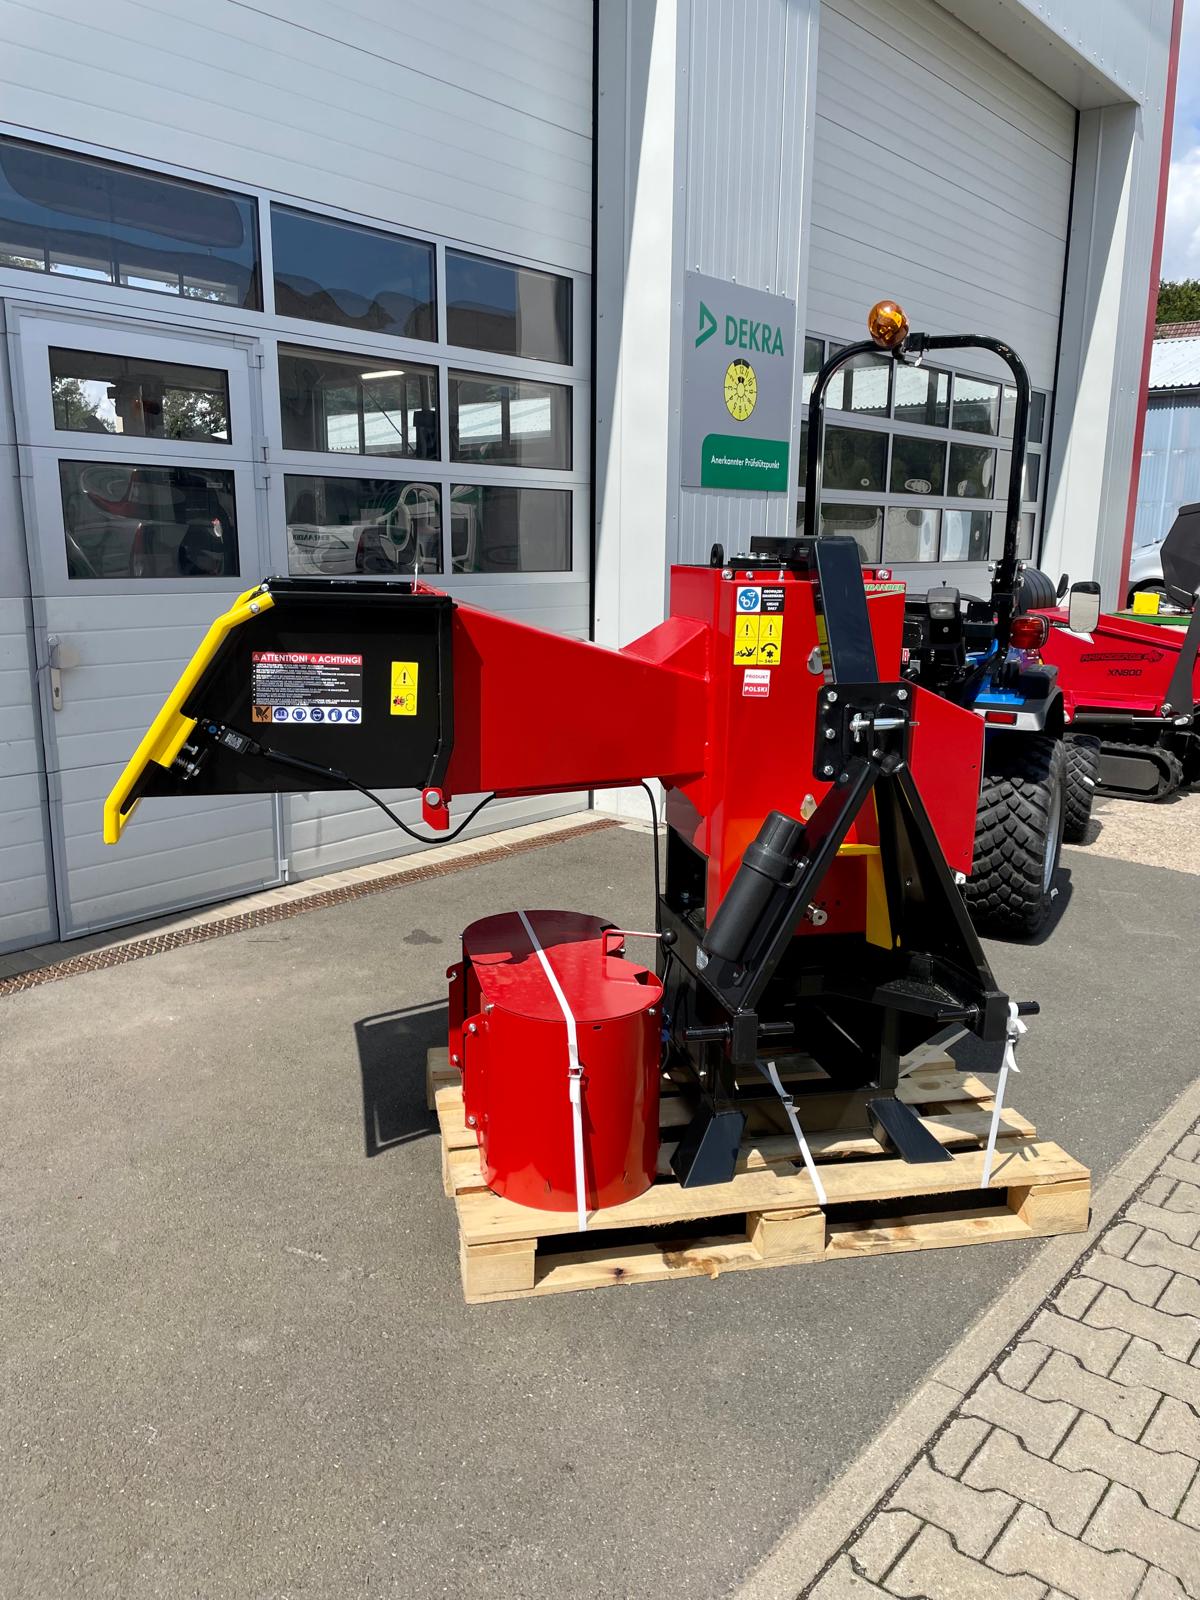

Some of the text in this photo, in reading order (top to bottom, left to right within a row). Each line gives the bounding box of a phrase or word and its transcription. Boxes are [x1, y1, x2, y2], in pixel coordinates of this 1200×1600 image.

[725, 314, 784, 357] DEKRA
[710, 455, 780, 470] Anerkannter Prüfstützpunkt
[260, 654, 361, 664] ATTENTION! ACHTUNG!
[1108, 669, 1143, 677] XN800
